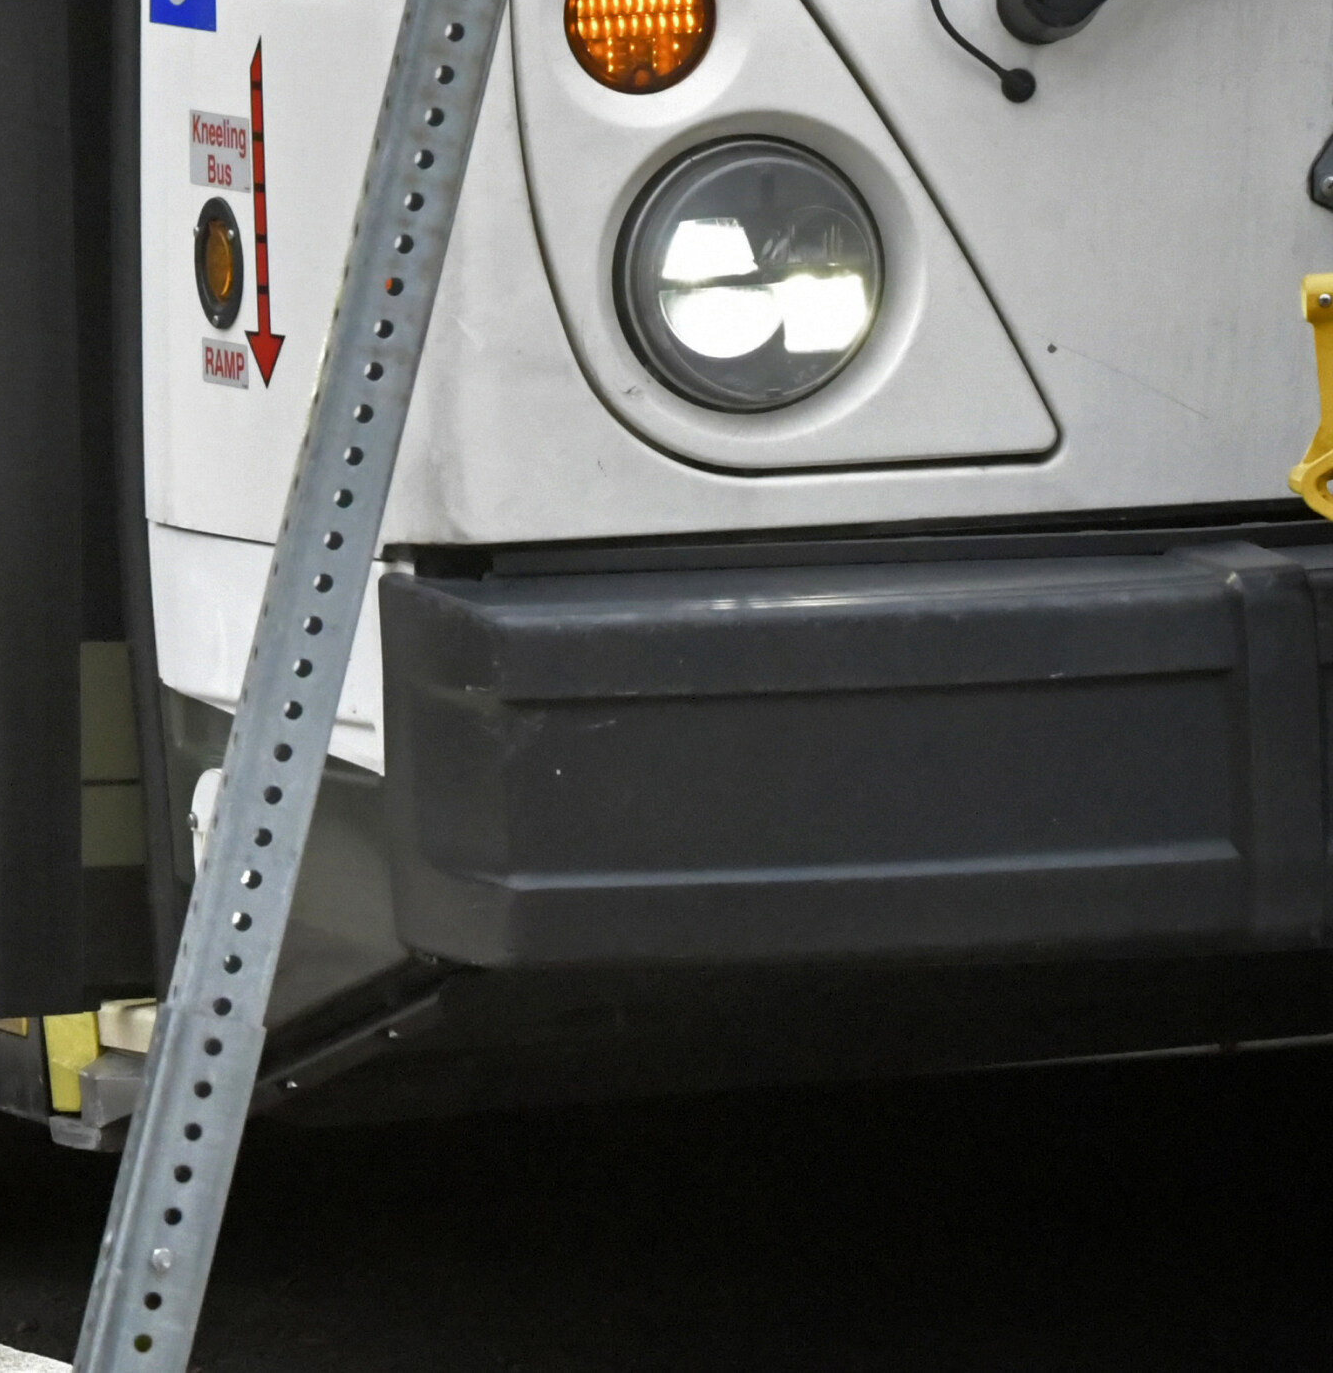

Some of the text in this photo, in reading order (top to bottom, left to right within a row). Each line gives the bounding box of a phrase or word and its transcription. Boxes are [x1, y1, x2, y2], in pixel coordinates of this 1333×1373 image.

[192, 114, 247, 158] Kneeling
[207, 154, 233, 186] Bus
[205, 346, 245, 381] RAMP
